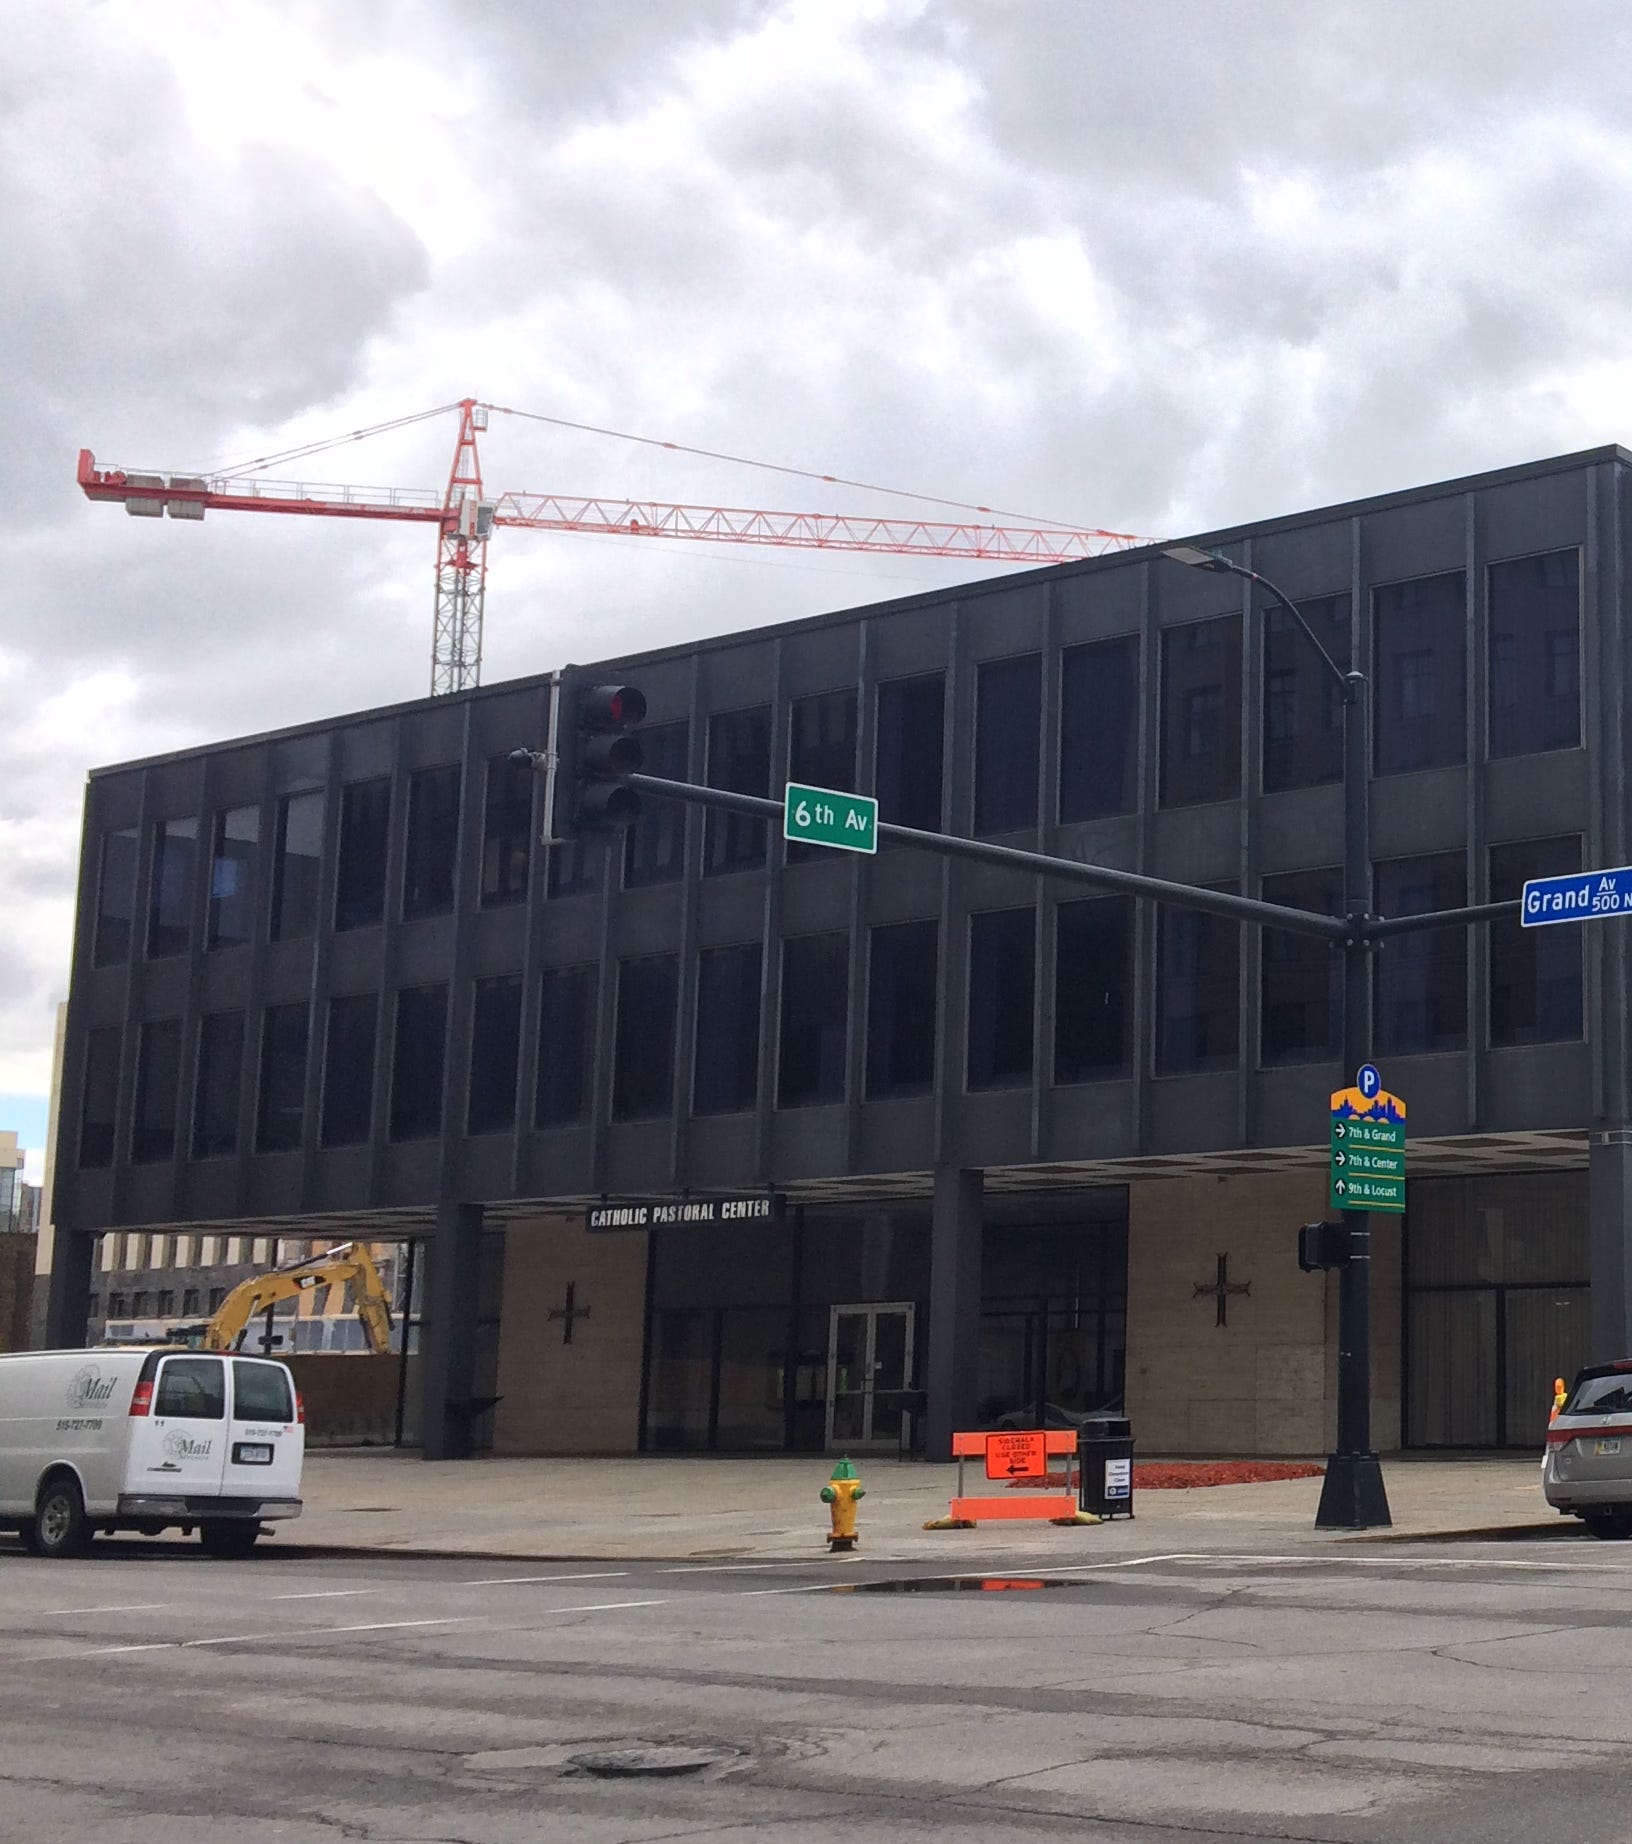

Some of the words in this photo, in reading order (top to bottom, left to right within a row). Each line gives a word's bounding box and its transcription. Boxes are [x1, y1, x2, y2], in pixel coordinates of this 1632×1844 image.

[795, 801, 835, 827] 6th
[844, 808, 868, 832] Av
[1527, 884, 1590, 914] Grand
[1598, 876, 1617, 892] Av
[1591, 894, 1620, 912] 500
[1363, 1070, 1375, 1094] P
[1348, 1127, 1362, 1139] 7th
[1363, 1128, 1370, 1140] &
[1371, 1129, 1396, 1142] Grand
[1348, 1155, 1362, 1166] 7th
[1363, 1156, 1370, 1167] &
[1371, 1157, 1398, 1169] Center
[1348, 1183, 1362, 1194] 9th
[1363, 1184, 1370, 1195] &
[1371, 1185, 1397, 1197] Locust
[590, 1207, 648, 1227] CATHOLIC
[652, 1203, 715, 1224] PASTORAL
[721, 1199, 770, 1219] CENTER
[81, 1376, 118, 1400] Mail
[179, 1440, 212, 1455] Mail
